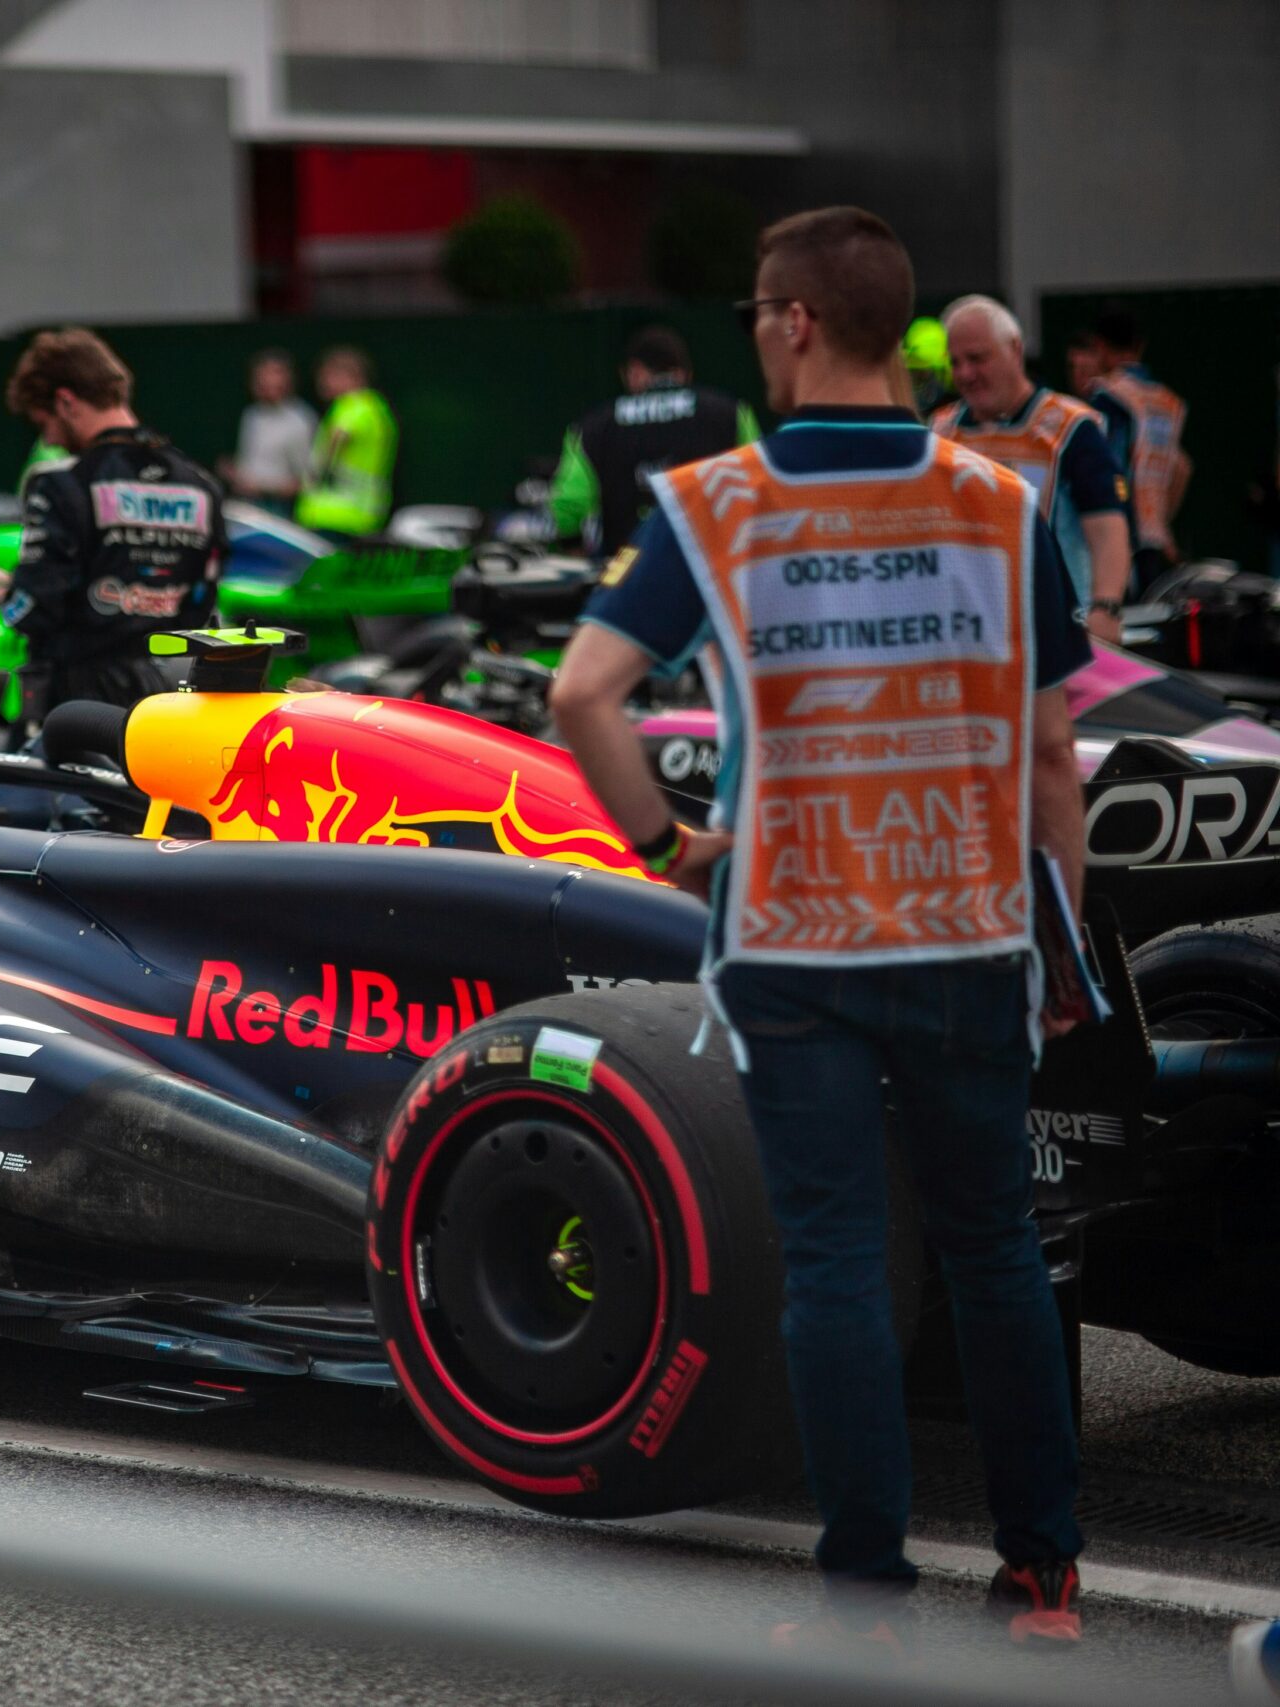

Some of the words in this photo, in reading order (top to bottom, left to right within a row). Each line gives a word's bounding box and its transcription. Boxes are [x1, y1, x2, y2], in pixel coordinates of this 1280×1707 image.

[782, 549, 939, 586] 0026-SPN
[749, 613, 945, 656] SCRUTINEER
[950, 611, 982, 643] F1
[761, 785, 989, 845] PITLANE
[770, 846, 842, 887] ALL
[852, 837, 991, 882] TIME
[187, 960, 338, 1050] Red
[345, 969, 496, 1059] Bull
